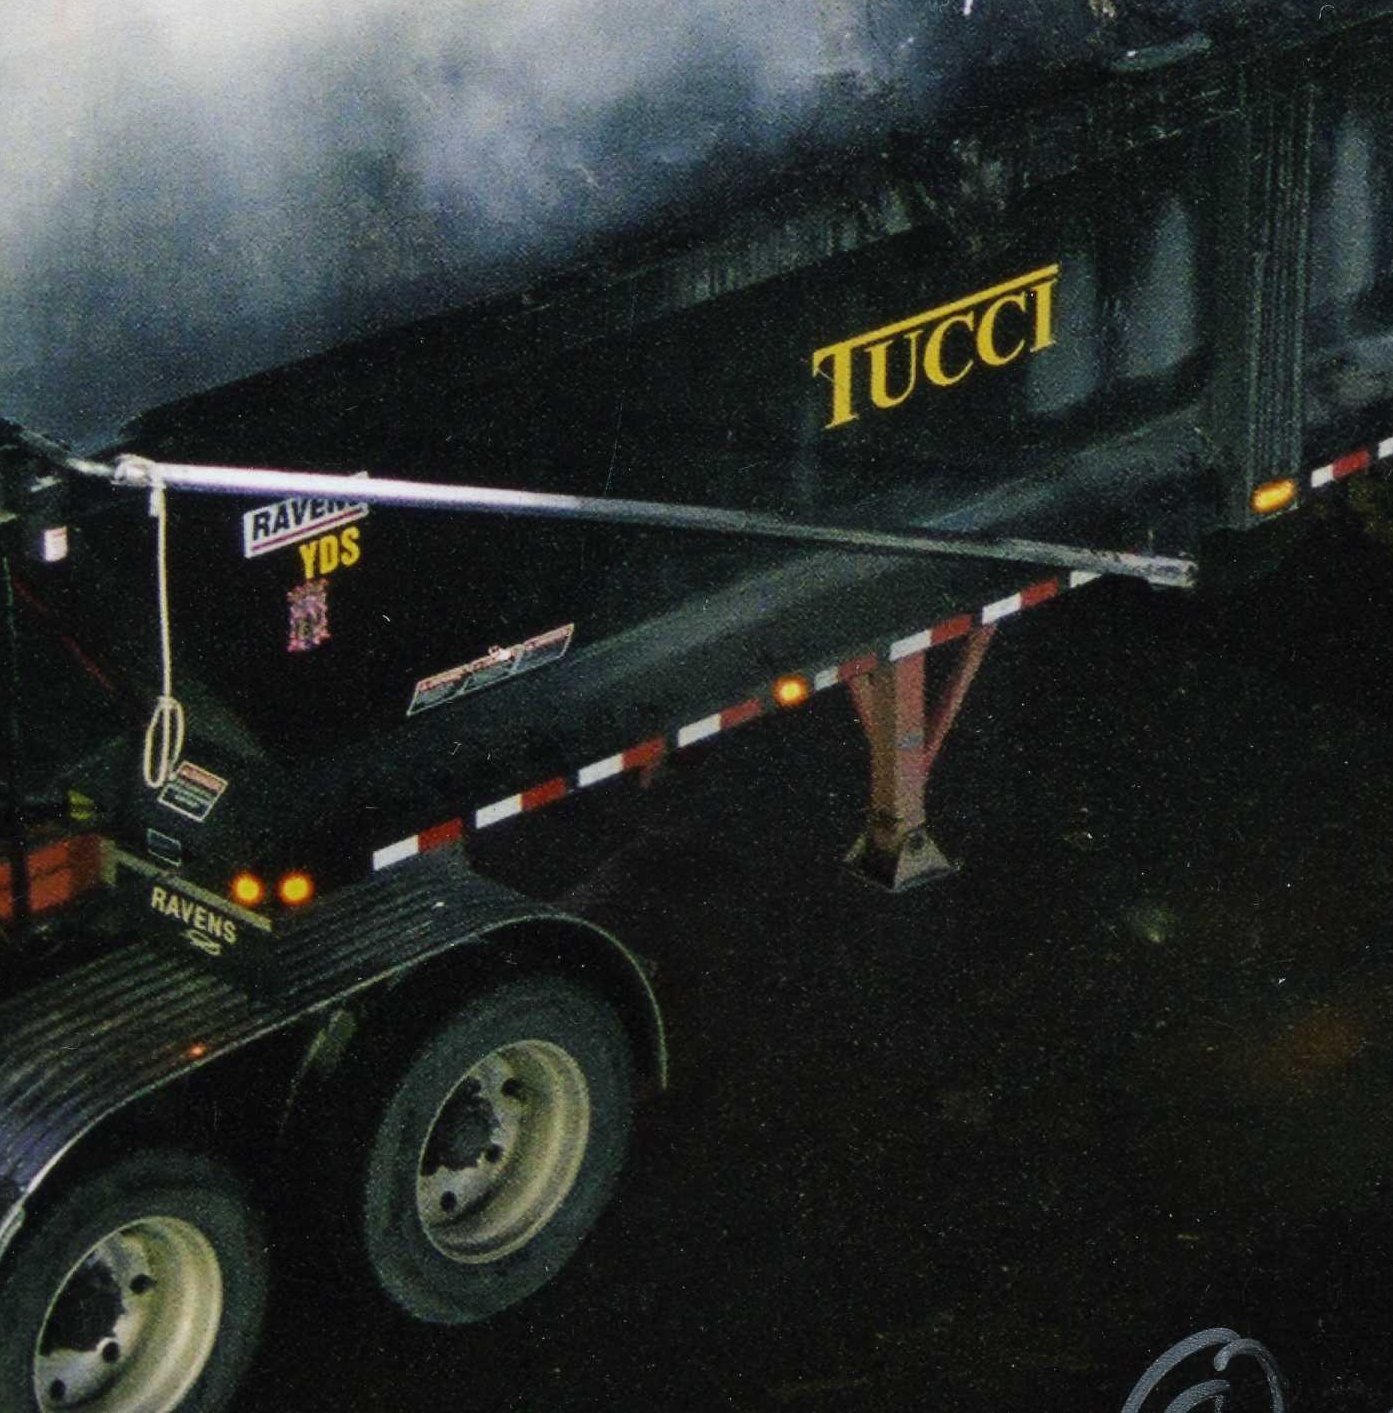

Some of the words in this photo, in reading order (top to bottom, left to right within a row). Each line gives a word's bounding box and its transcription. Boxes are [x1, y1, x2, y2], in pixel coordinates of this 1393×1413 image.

[812, 263, 1061, 429] TUCCI
[251, 493, 363, 541] RAVEN
[299, 526, 361, 579] YDS
[151, 886, 237, 944] RAVENS
